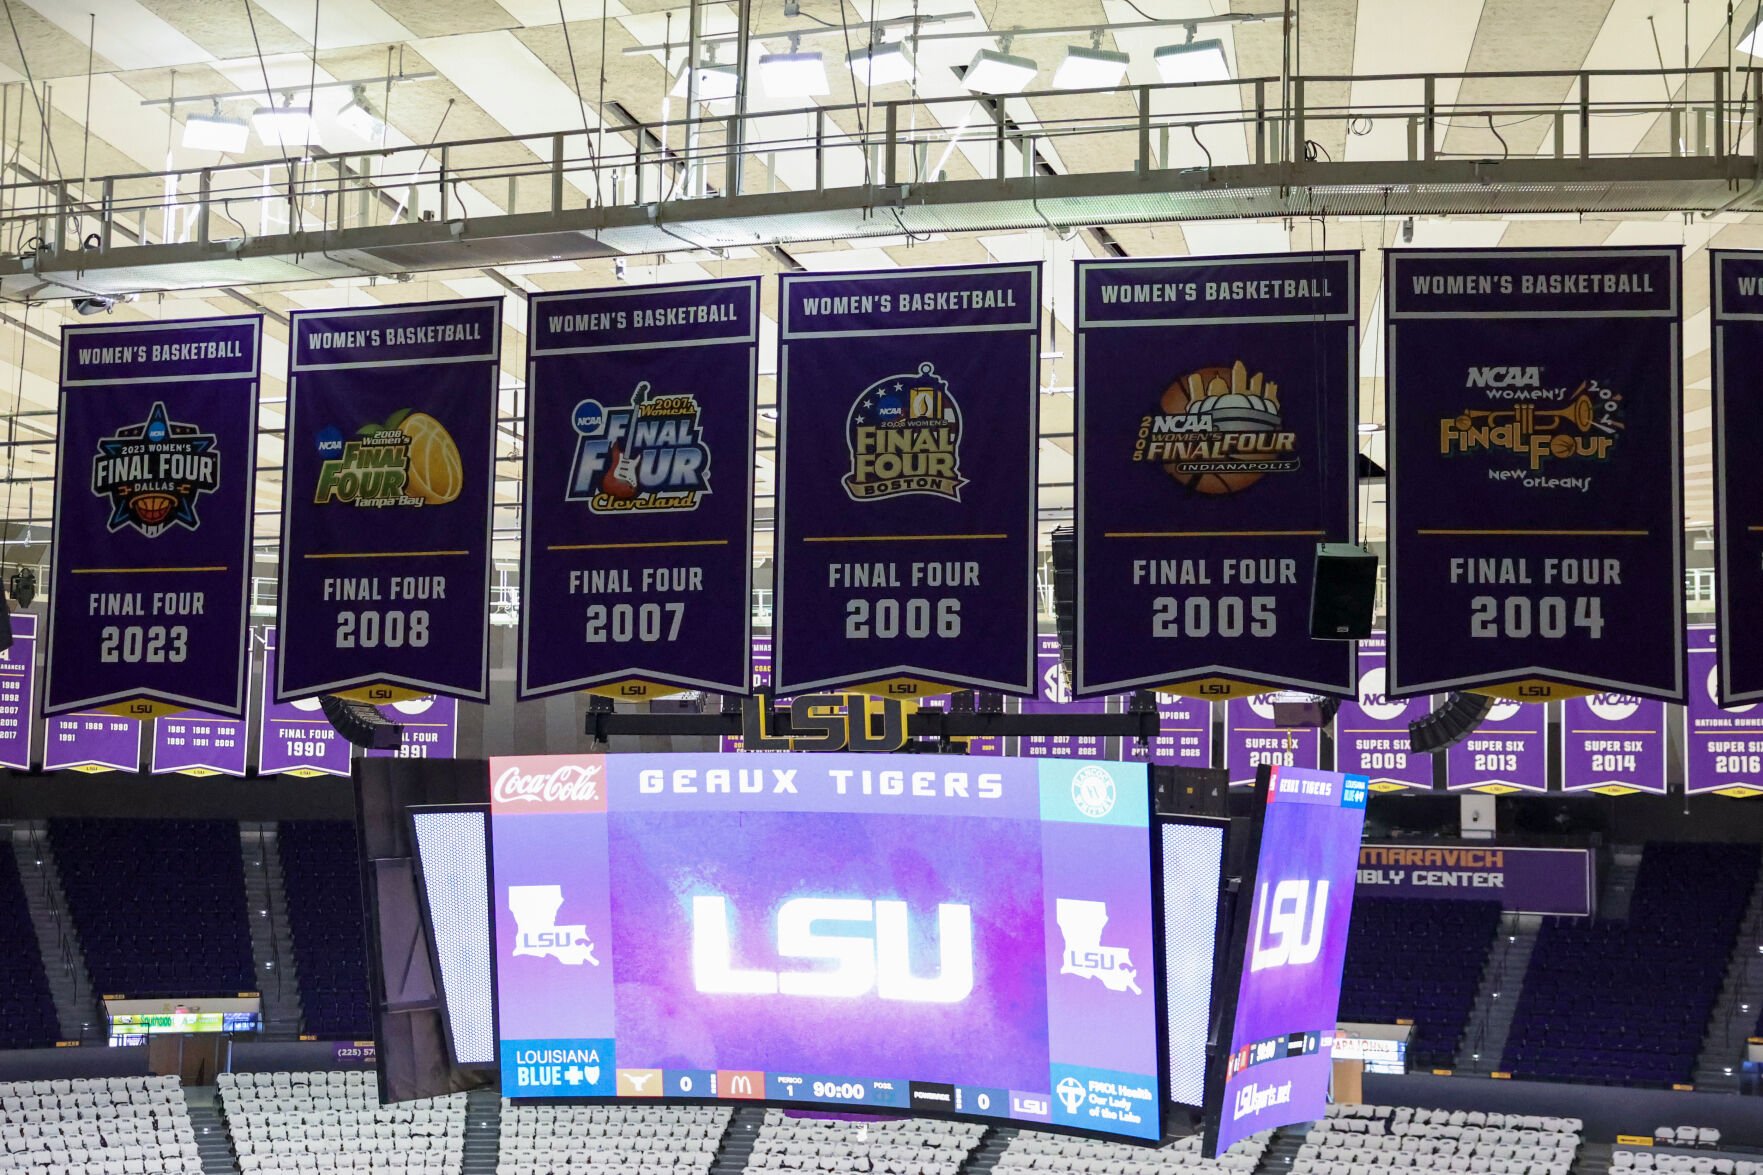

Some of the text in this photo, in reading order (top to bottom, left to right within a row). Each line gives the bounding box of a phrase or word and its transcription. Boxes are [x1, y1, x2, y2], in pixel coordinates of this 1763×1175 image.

[1102, 279, 1332, 304] WOMEN'S BASKETBALL
[1412, 274, 1653, 294] WOMEN'S BASKETBALL
[803, 289, 1016, 315] WOMEN'S BASKETBALL
[549, 304, 737, 333] WOMEN'S BASKETBALL
[309, 323, 480, 349] WOMEN'S BASKETBALL
[79, 341, 242, 364] WOMEN'S BASKETBALL
[1466, 367, 1540, 387] NCAA
[656, 399, 687, 409] 2007
[577, 417, 602, 426] NCAA
[1153, 414, 1212, 433] NCAA
[318, 441, 342, 450] NCAA
[362, 436, 411, 445] Women's
[856, 426, 954, 454] FINAL
[1152, 433, 1221, 441] WOMEN'S
[121, 444, 191, 455] 2023 WOMEN'S
[343, 442, 407, 468] FINAL
[1147, 433, 1296, 460] FINAL FOUR
[97, 454, 213, 486] FINAL FOUR
[856, 453, 956, 482] FOUR
[1183, 462, 1291, 471] INDIANAPOLIS
[135, 482, 174, 491] DALLAS
[314, 460, 406, 503] FOUR
[864, 478, 942, 495] BOSTON
[354, 496, 424, 508] Tampa Bay
[592, 492, 697, 510] Cleveland
[829, 561, 980, 587] FINAL FOUR
[1134, 559, 1297, 585] FINAL FOUR
[1451, 558, 1621, 585] FINAL FOUR
[324, 577, 446, 600] FINAL FOUR
[570, 568, 703, 593] FINAL FOUR
[90, 592, 204, 616] FINAL FOUR
[586, 603, 685, 642] 2007
[846, 599, 961, 638] 2006
[1153, 596, 1276, 637] 2005
[1471, 596, 1604, 639] 2004
[336, 610, 429, 648] 2008
[101, 626, 188, 662] 2023
[369, 690, 392, 699] LSU
[621, 686, 646, 695] LSU
[889, 684, 917, 694] LSU
[1200, 684, 1230, 694] LSU
[1519, 687, 1550, 696] LSU
[130, 705, 152, 713] LSU
[1159, 712, 1190, 720] MPIONS
[742, 693, 909, 751] LSU
[1695, 719, 1732, 727] NATIONAL
[279, 729, 334, 739] FINAL FOUR
[413, 733, 438, 742] FOUR
[287, 741, 325, 756] 1990
[400, 745, 427, 758] 991
[1246, 738, 1278, 748] SUPER
[1356, 739, 1411, 750] SUPER SIX
[1468, 741, 1524, 751] SUPER SIX
[1585, 741, 1642, 751] SUPER SIX
[1708, 742, 1745, 752] SUPER
[1250, 752, 1294, 767] 2008
[1361, 753, 1406, 769] 2009
[1475, 755, 1517, 771] 2013
[1592, 755, 1636, 772] 2014
[1716, 756, 1760, 773] 2016
[493, 765, 601, 803] Coca-Cola
[640, 770, 1002, 798] GEAUX TIGERS
[1360, 848, 1504, 867] MARAVICH
[1412, 871, 1504, 887] CENTER
[1251, 879, 1329, 973] LSU
[524, 932, 571, 948] LSU
[692, 895, 974, 1004] LSU
[1071, 951, 1115, 970] LSU
[516, 1050, 599, 1064] LOUISIANA
[517, 1067, 561, 1086] BLUE
[680, 1076, 692, 1091] 0
[787, 1086, 793, 1097] 1
[813, 1082, 864, 1099] 90:00
[978, 1094, 989, 1109] 0
[1014, 1098, 1047, 1115] LSU
[1109, 1096, 1131, 1111] Lady
[1089, 1106, 1141, 1124] of the Lake
